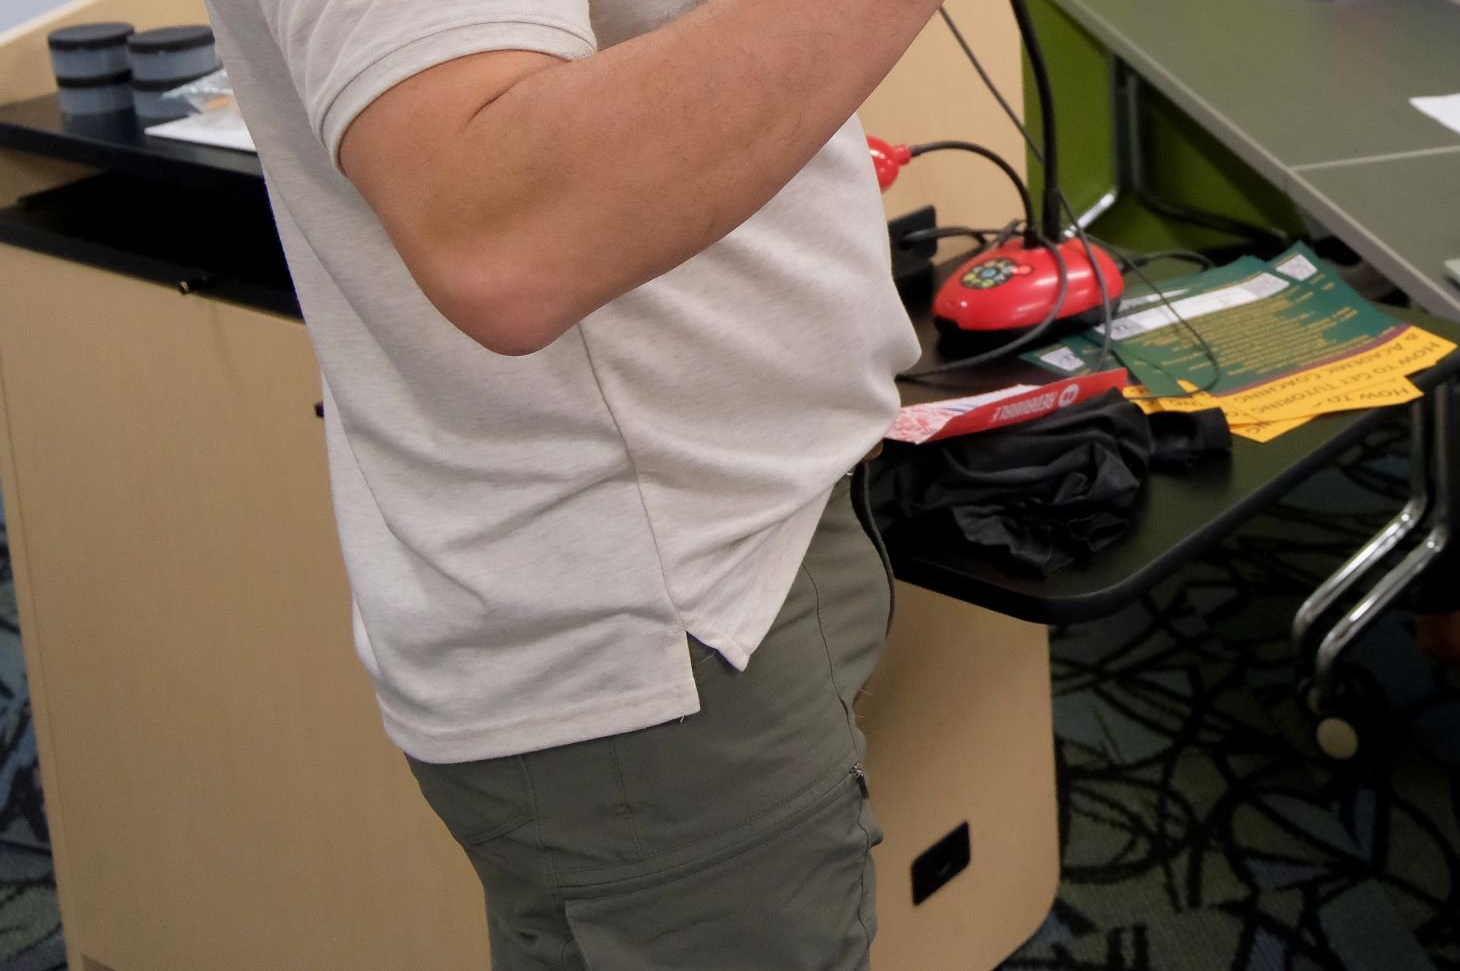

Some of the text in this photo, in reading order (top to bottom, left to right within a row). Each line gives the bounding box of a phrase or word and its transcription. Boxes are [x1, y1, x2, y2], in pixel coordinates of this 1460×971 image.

[1398, 341, 1442, 367] HOW
[1233, 372, 1322, 403] COACHING
[1250, 383, 1337, 413] TUTORING
